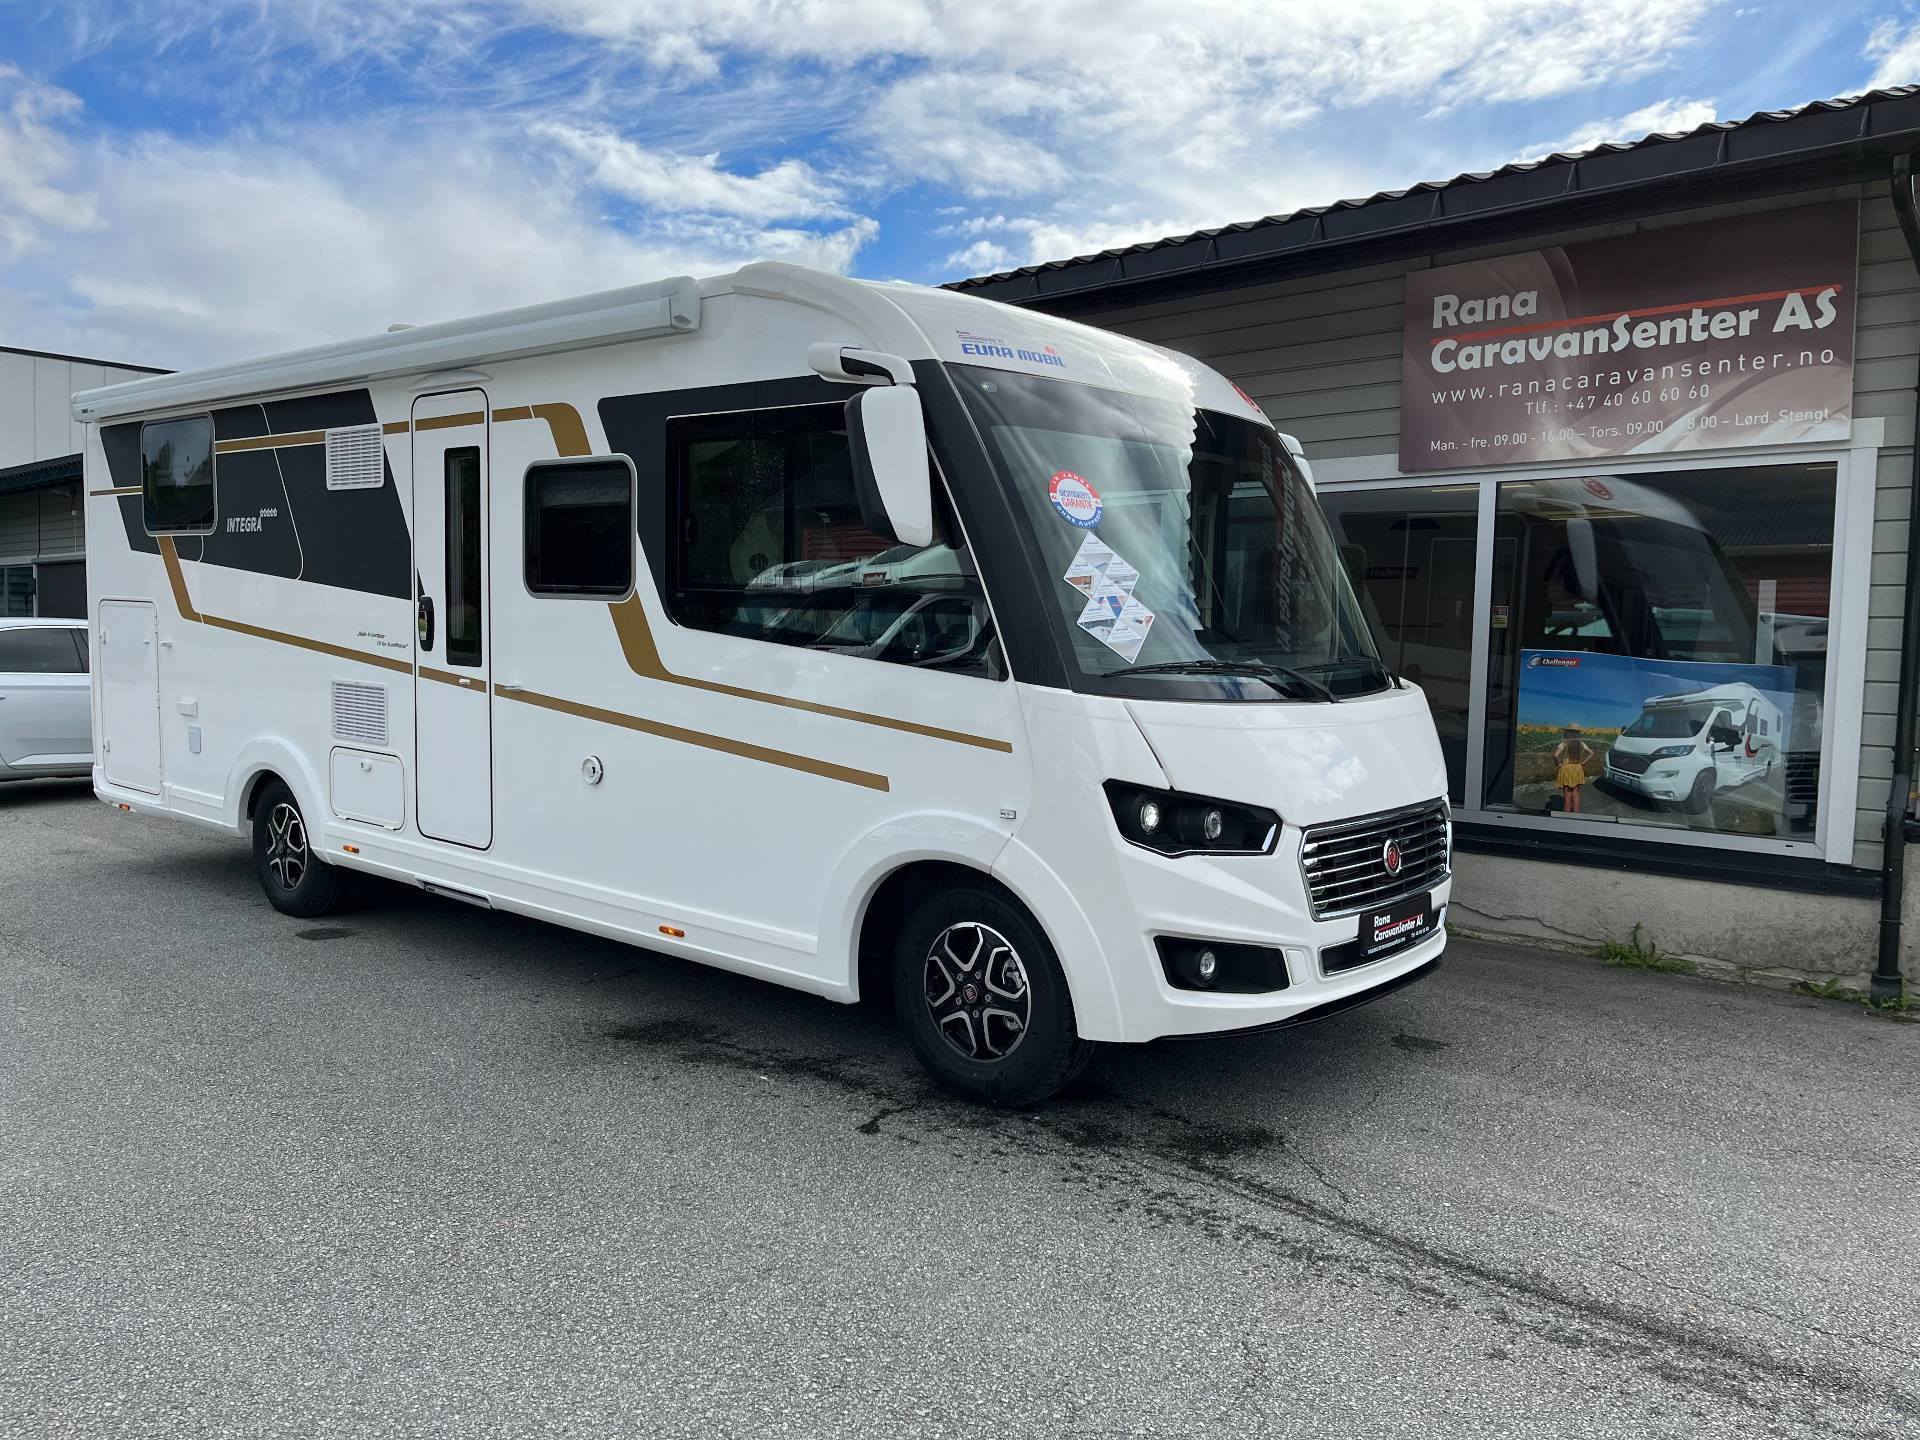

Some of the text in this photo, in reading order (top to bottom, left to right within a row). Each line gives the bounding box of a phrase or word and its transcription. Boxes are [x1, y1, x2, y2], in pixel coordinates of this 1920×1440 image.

[1432, 290, 1538, 329] Rana
[1431, 287, 1838, 374] CaravanSenter AS
[961, 343, 1067, 368] EURA MOBIL
[1431, 349, 1834, 404] www.ranacaravansenter.no
[1525, 384, 1709, 415] Tlf.: +47 40 60 60 60
[1430, 440, 1459, 452] Man.
[1471, 437, 1491, 449] fre.
[1494, 432, 1527, 447] 09.00
[1540, 428, 1575, 442] 16.00
[1589, 425, 1622, 438] Tors.
[1626, 420, 1664, 435] 09.00
[1735, 411, 1774, 426] Lørd.
[1778, 407, 1831, 424] Stengt
[226, 516, 263, 533] INTEGRA
[1542, 658, 1577, 667] Challenger
[1374, 915, 1391, 928] Rana
[1374, 919, 1416, 942] CaravanSenter
